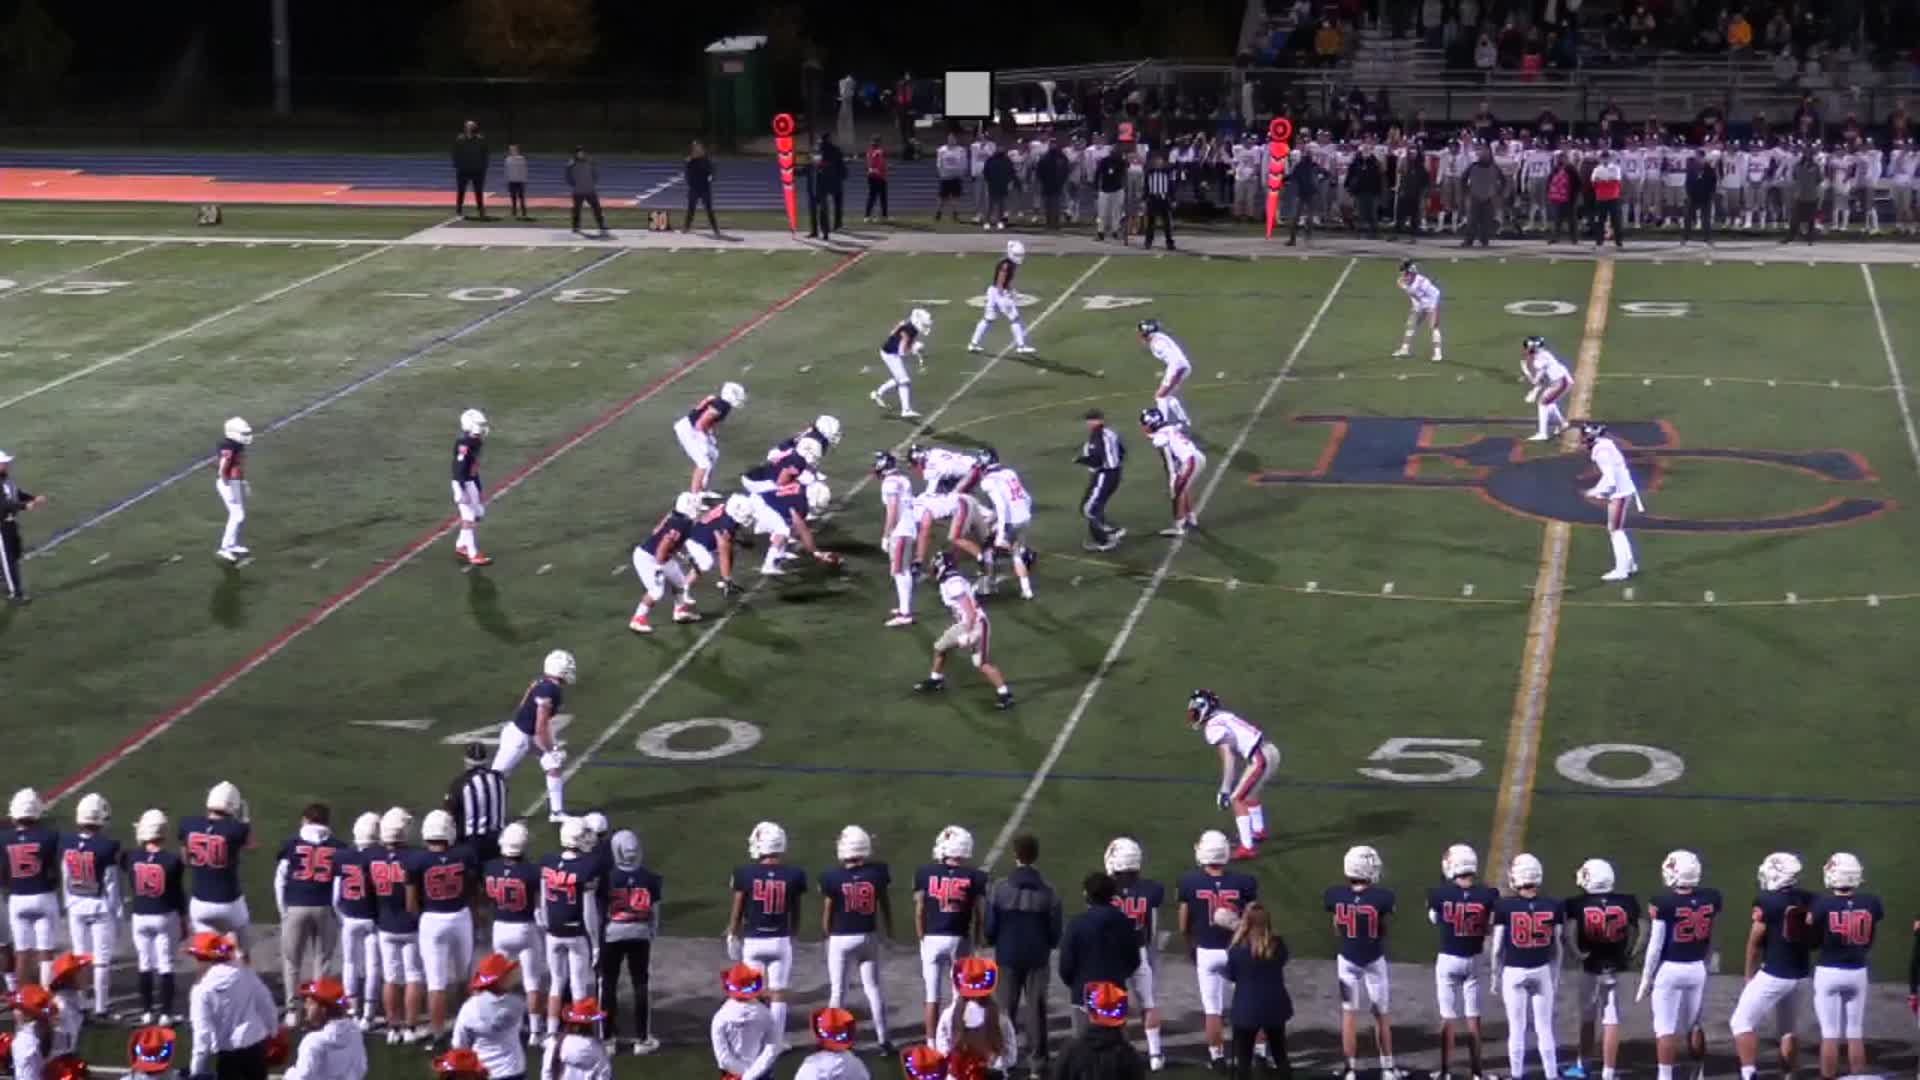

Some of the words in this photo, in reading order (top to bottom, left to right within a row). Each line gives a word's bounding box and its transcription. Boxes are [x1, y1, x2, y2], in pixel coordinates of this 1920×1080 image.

[650, 210, 667, 230] 30
[1357, 738, 1685, 788] 50
[7, 842, 42, 878] 15
[188, 832, 227, 869] 50
[294, 845, 337, 883] 35
[133, 862, 166, 897] 19
[485, 875, 527, 912] 43
[752, 879, 786, 914] 41
[841, 881, 875, 914] 18
[1335, 903, 1378, 938] 47
[1510, 911, 1554, 948] 85
[1674, 905, 1713, 942] 26
[1829, 909, 1873, 944] 40
